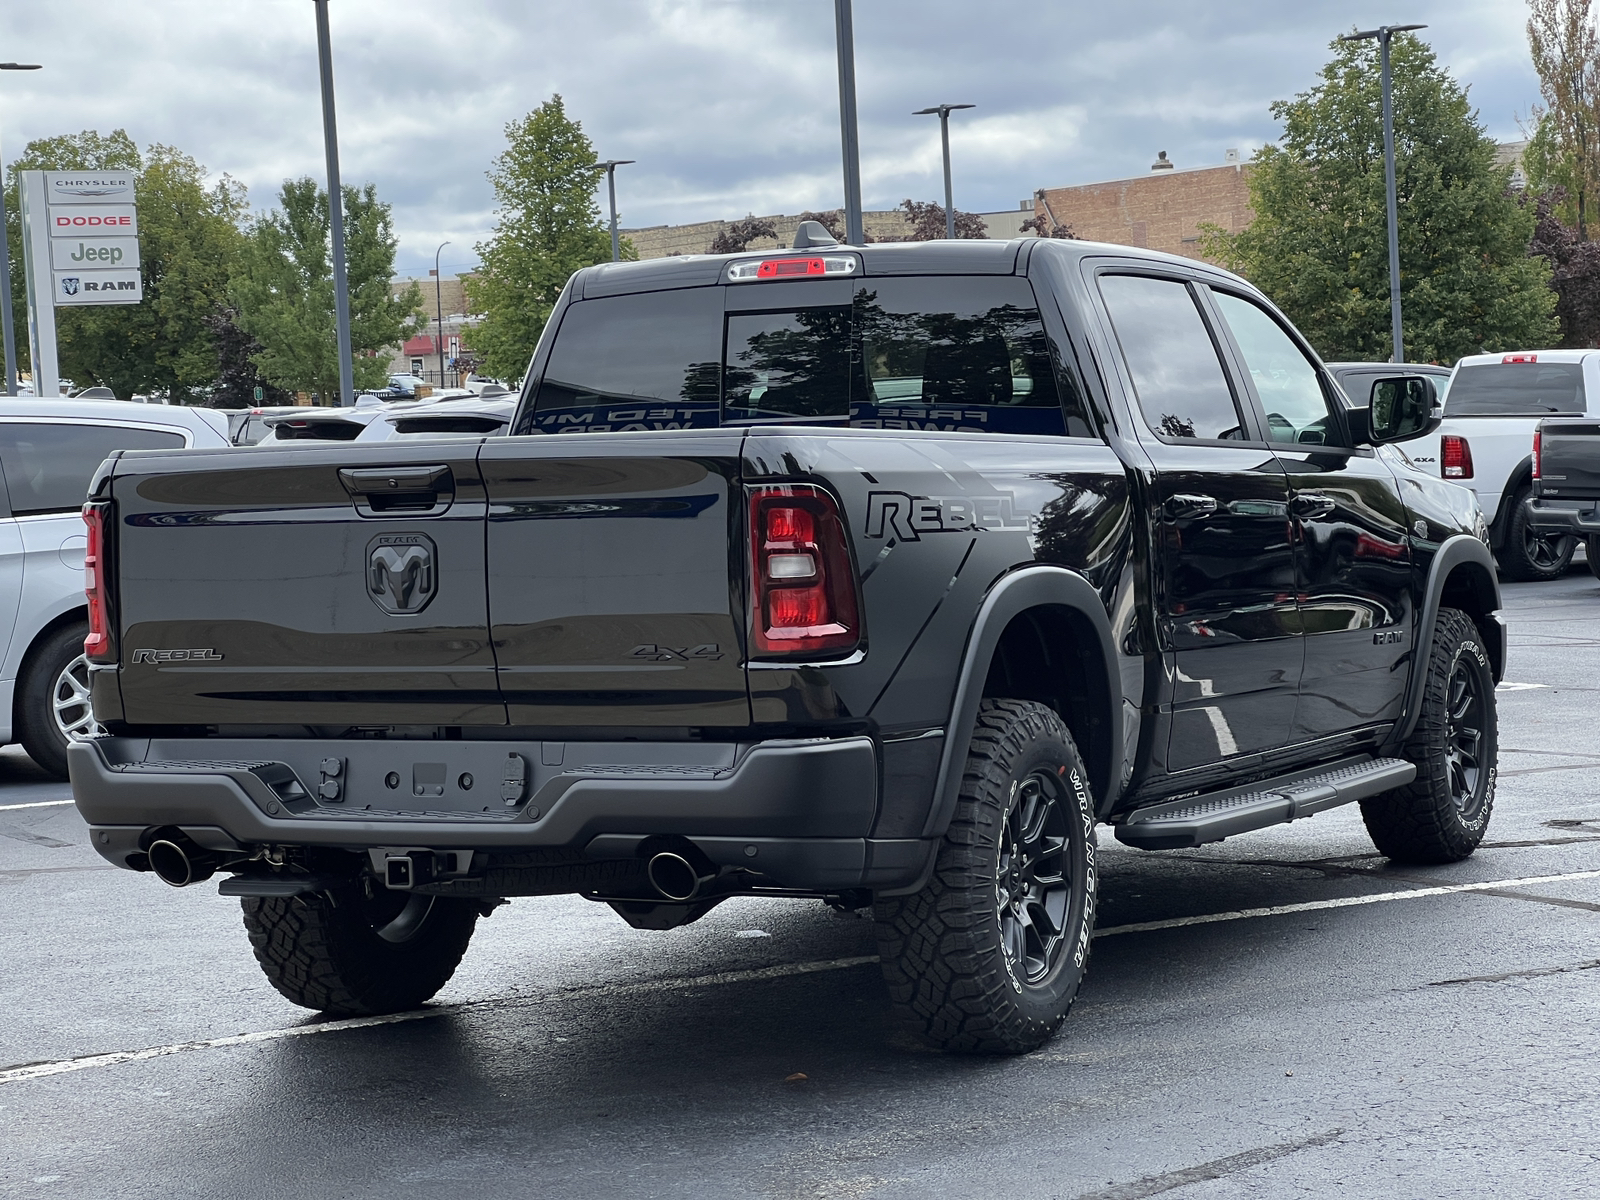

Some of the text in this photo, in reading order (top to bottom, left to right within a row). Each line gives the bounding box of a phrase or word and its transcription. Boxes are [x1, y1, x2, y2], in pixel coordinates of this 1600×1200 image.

[55, 179, 127, 187] CHRYSLER
[56, 216, 131, 226] DODGE
[70, 243, 123, 264] Jeep
[84, 281, 136, 291] RAM
[864, 490, 1032, 542] REBEL
[379, 536, 420, 544] RAM
[132, 648, 224, 664] REBEL
[1070, 768, 1095, 968] WRANGLER
